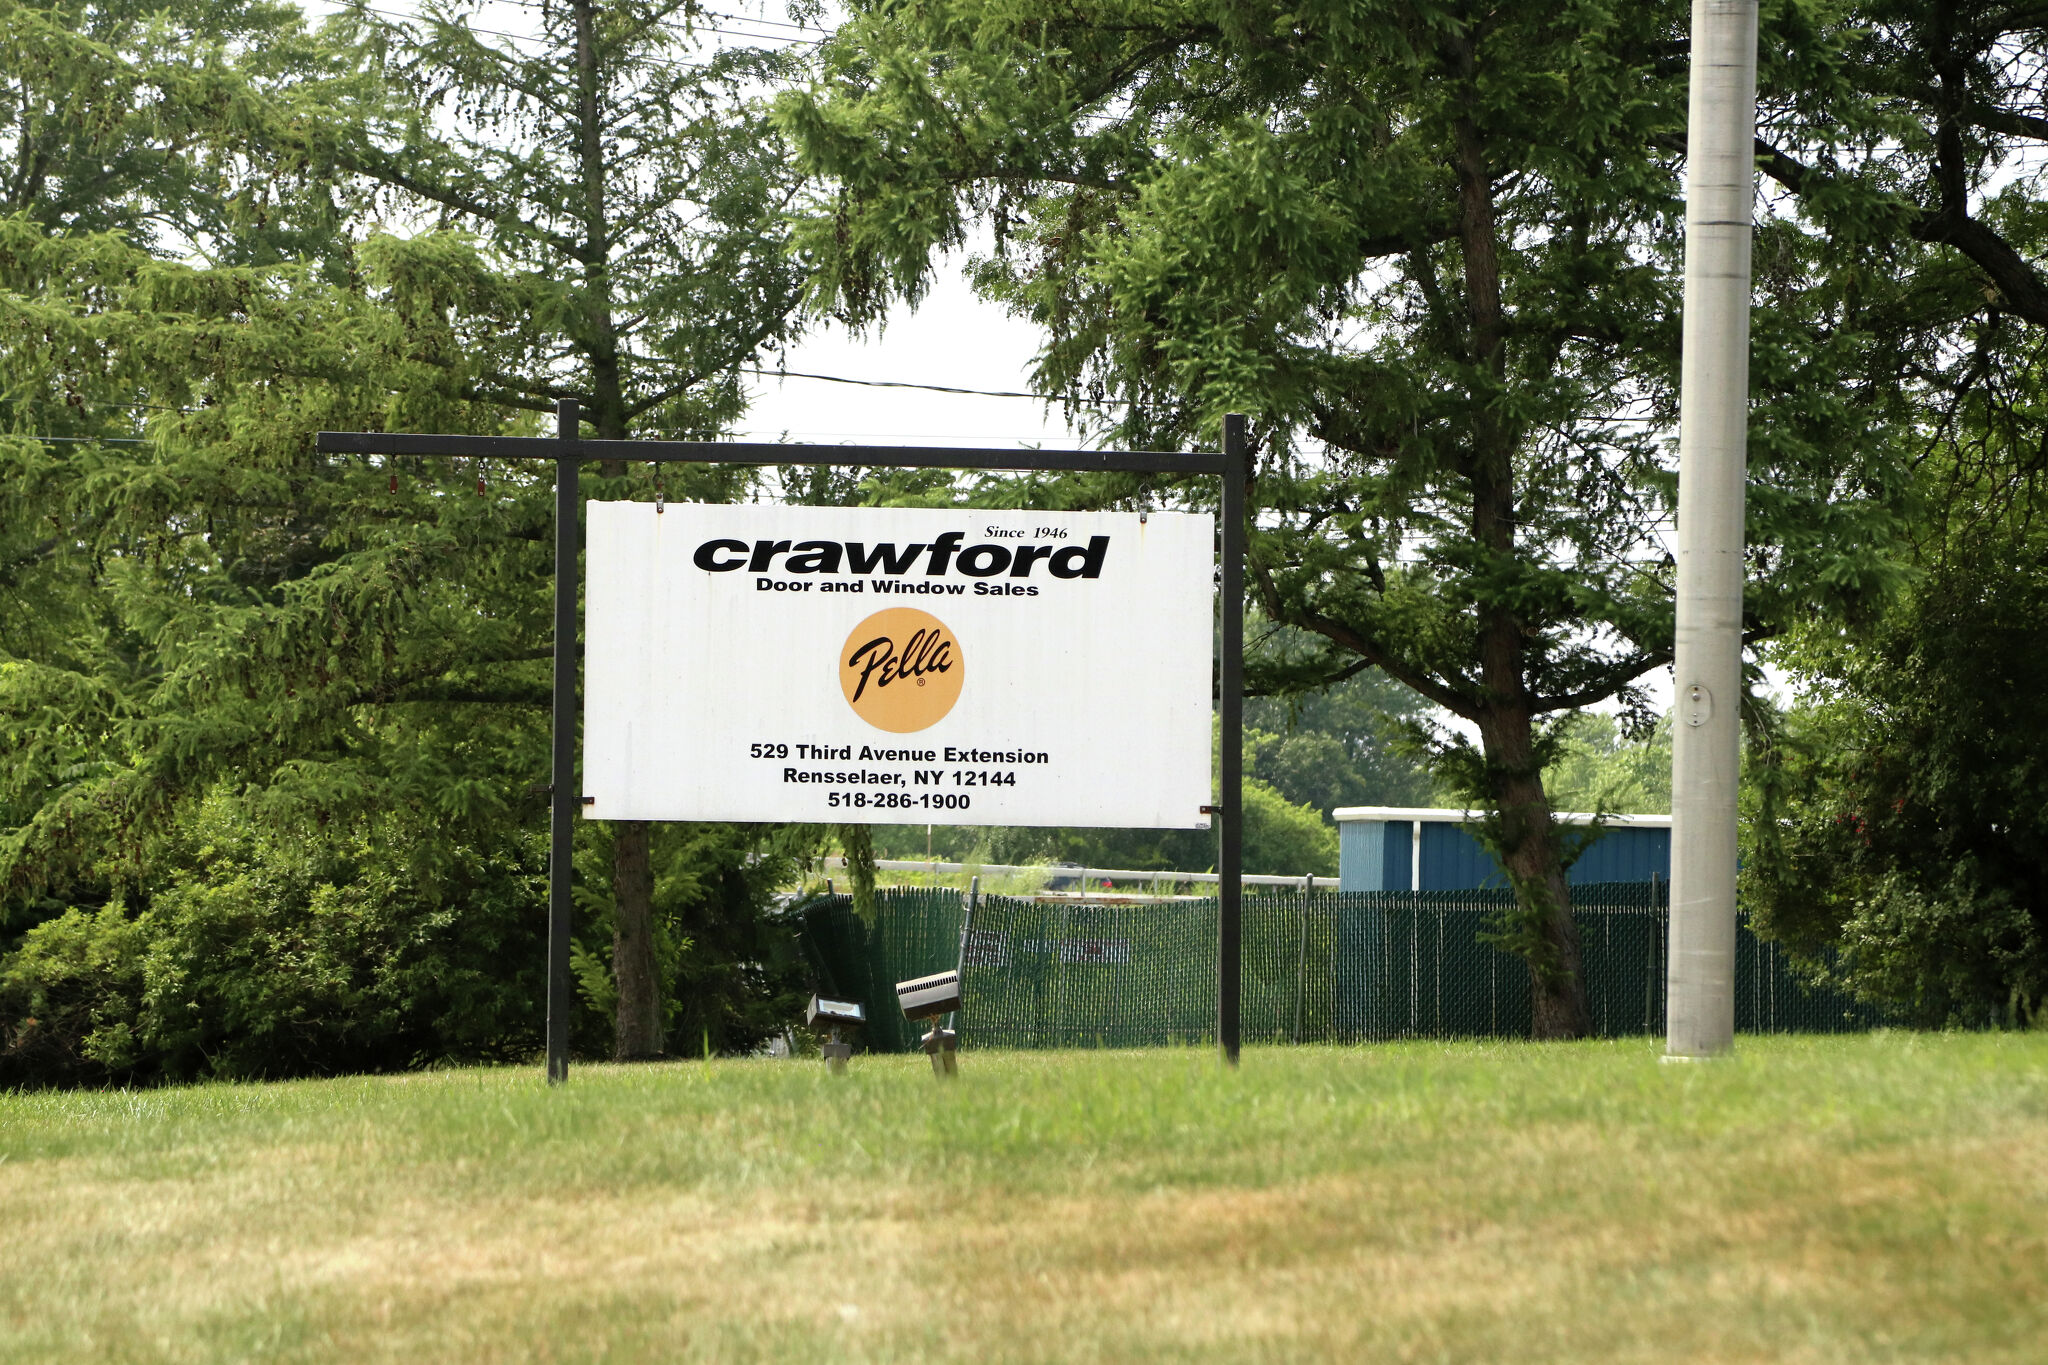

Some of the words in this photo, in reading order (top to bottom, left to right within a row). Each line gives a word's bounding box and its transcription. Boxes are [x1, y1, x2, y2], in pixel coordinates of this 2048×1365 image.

[984, 525, 1025, 539] Since
[1033, 527, 1068, 540] 1946
[693, 531, 1111, 580] crawford
[756, 577, 813, 593] Door
[819, 579, 864, 593] and
[871, 579, 966, 596] Window
[973, 581, 1039, 597] Sales
[848, 628, 954, 703] Pella
[750, 743, 789, 759] 529
[795, 744, 851, 761] Third
[858, 745, 937, 762] Avenue
[944, 747, 1049, 764] Extension
[783, 767, 906, 789] Rensselaer,
[914, 770, 945, 786] NY
[952, 770, 1017, 787] 12144
[827, 792, 971, 810] 518-286-1900
